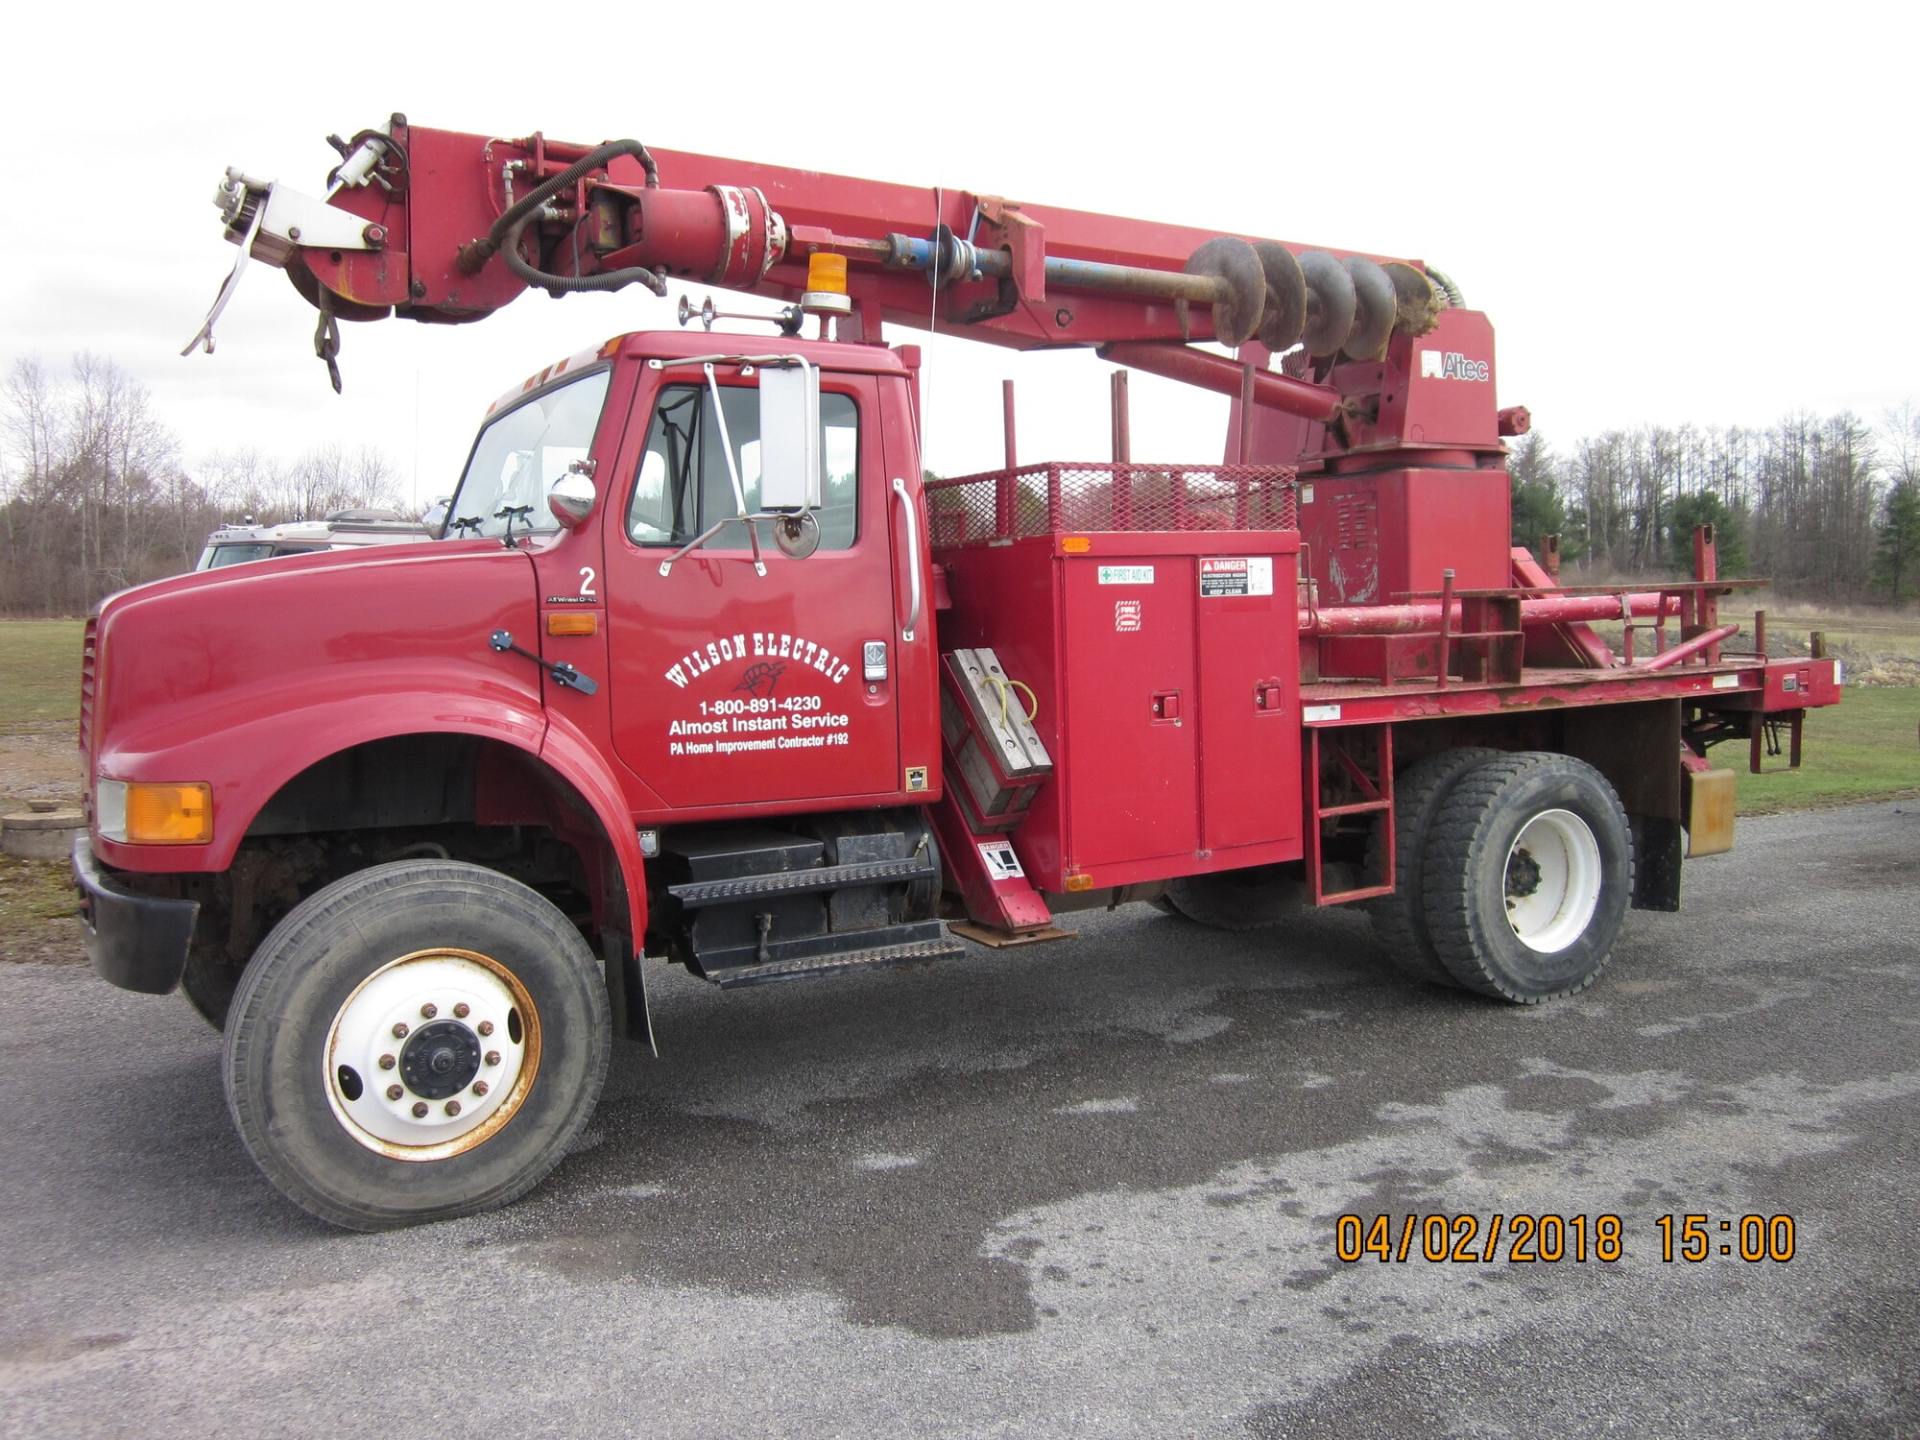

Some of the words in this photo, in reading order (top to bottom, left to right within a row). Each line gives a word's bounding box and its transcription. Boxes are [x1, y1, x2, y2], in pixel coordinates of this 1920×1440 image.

[1442, 352, 1488, 381] Altec
[1114, 569, 1131, 581] FIRST
[1132, 569, 1142, 581] AID
[1143, 568, 1153, 580] KIT
[1214, 560, 1247, 571] DANGER
[580, 566, 596, 595] 2
[665, 634, 746, 688] WILSON
[753, 633, 850, 684] ELECTRIC
[700, 696, 821, 715] 1-800-891-4230
[669, 720, 728, 736] Almost
[733, 715, 787, 732] Instant
[792, 712, 849, 729] Service
[670, 742, 684, 755] PA
[686, 741, 713, 754] Home
[716, 738, 776, 754] Improvement
[778, 735, 824, 749] Contractor
[827, 732, 849, 745] #192
